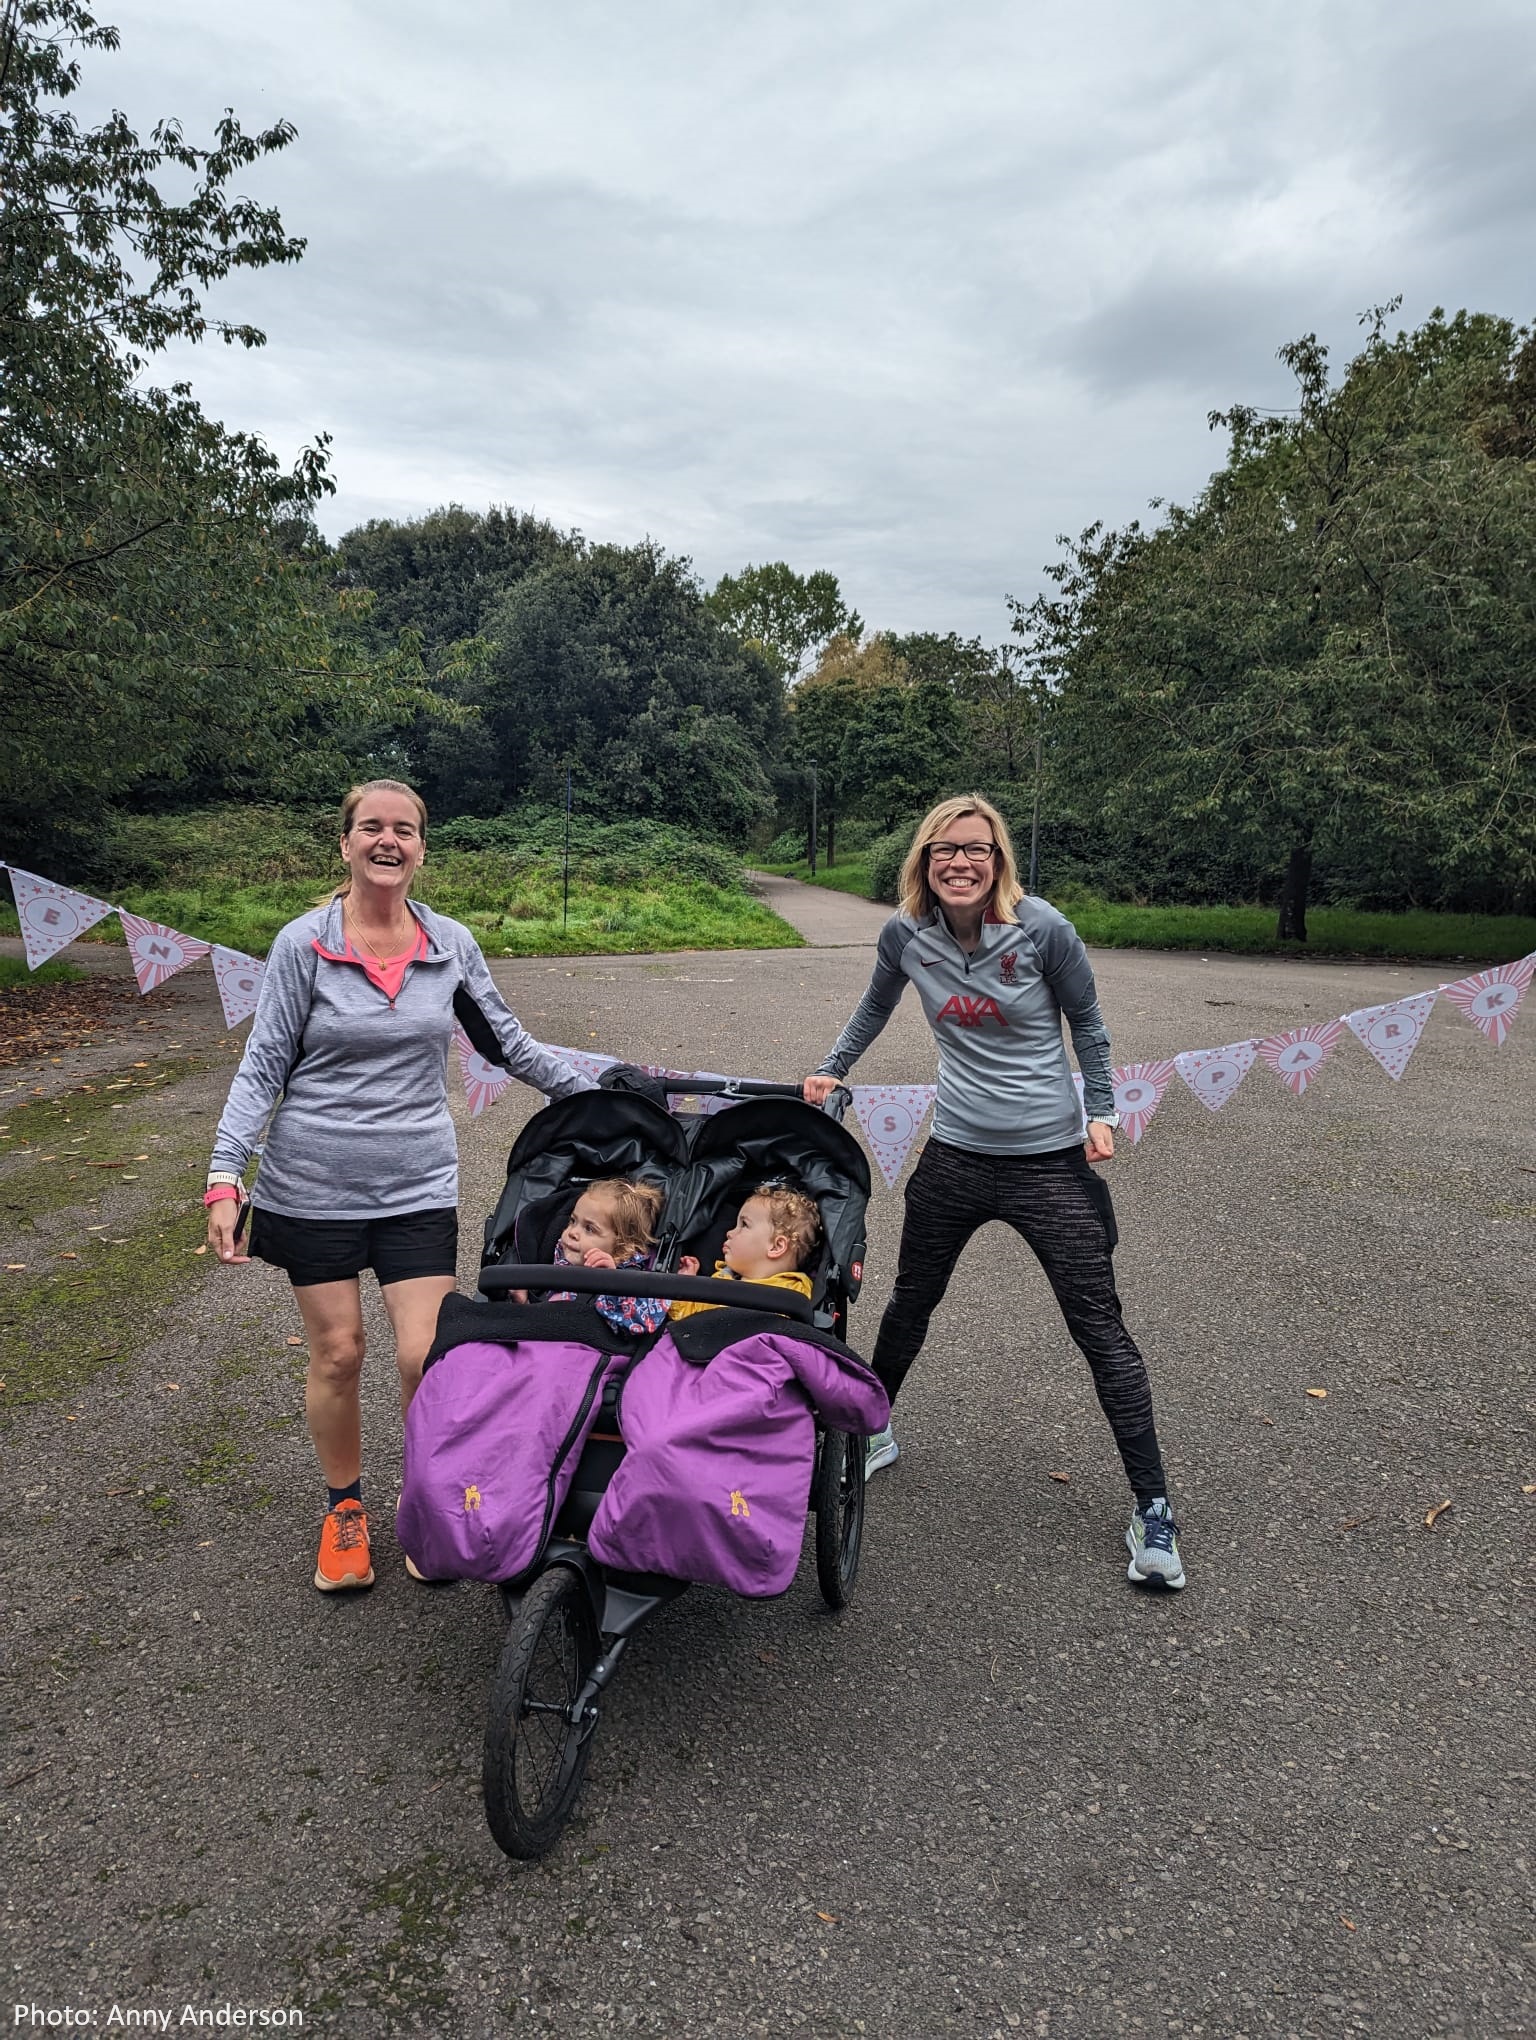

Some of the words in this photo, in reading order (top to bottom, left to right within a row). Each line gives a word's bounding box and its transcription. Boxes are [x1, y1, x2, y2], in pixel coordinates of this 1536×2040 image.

[43, 907, 61, 926] E
[149, 941, 172, 960] N
[1486, 992, 1505, 1010] K
[936, 995, 1009, 1027] AXA
[1384, 1022, 1401, 1039] R
[1290, 1048, 1312, 1065] A
[1210, 1070, 1226, 1085] P
[1124, 1087, 1143, 1104] O
[883, 1115, 897, 1133] S
